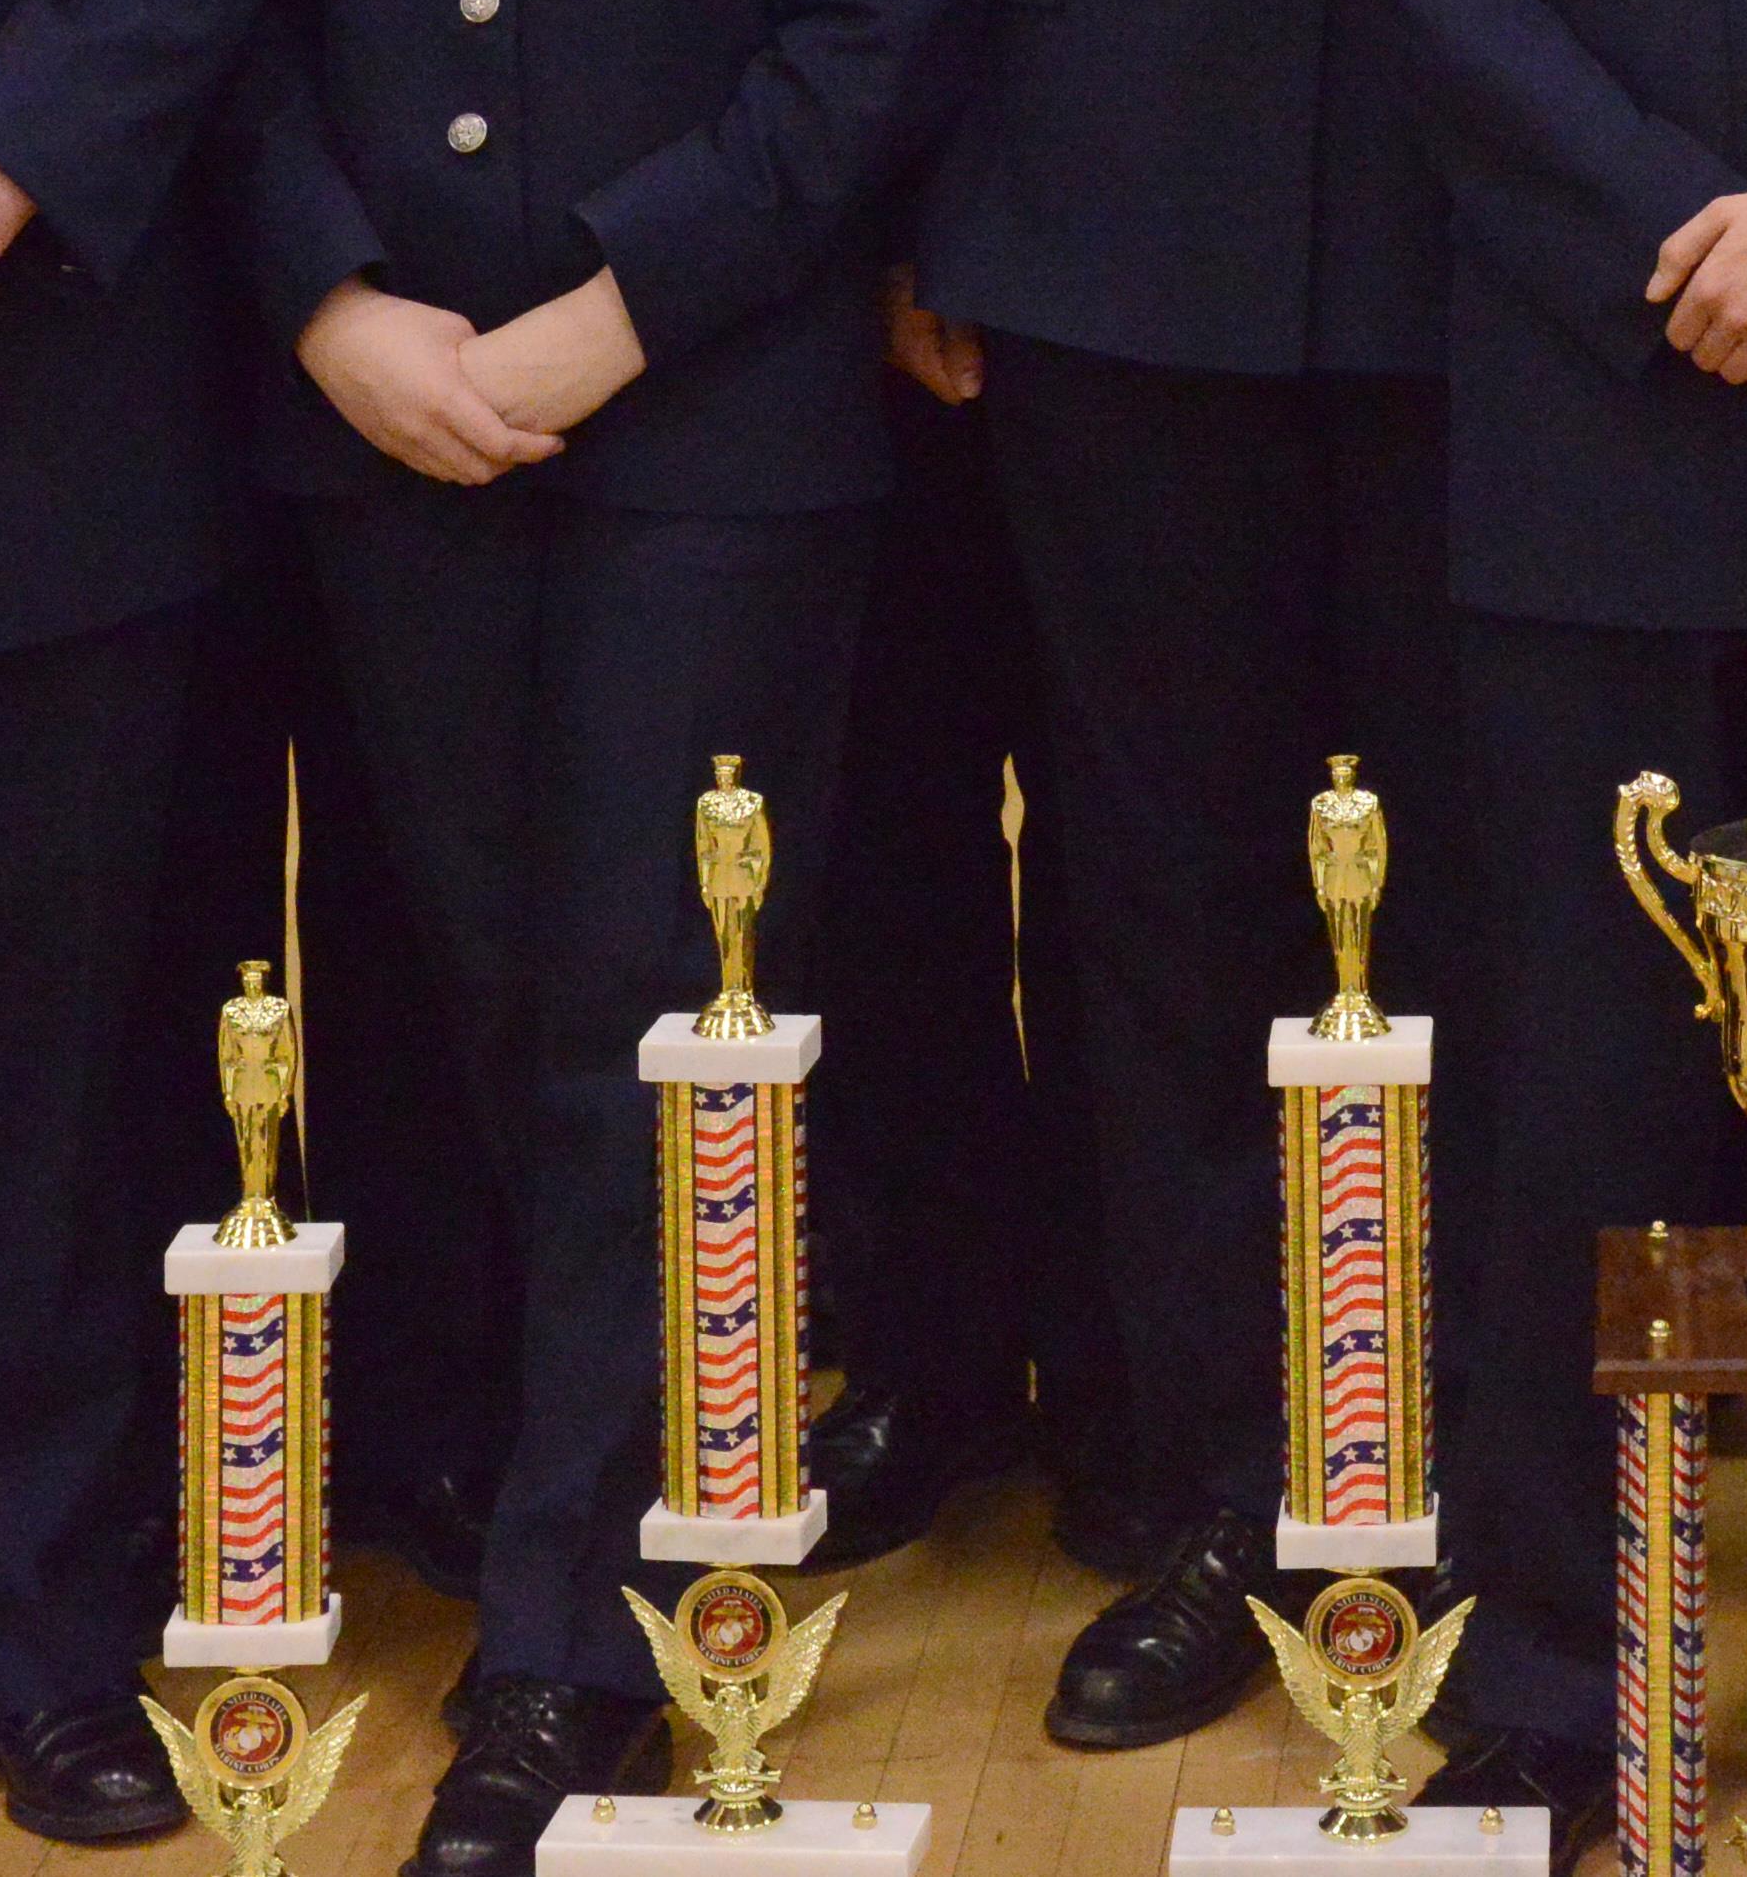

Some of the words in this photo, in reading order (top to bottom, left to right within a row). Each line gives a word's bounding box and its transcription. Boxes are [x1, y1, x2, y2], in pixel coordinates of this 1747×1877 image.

[698, 1586, 731, 1610] UNITED
[732, 1587, 763, 1611] STATES
[1330, 1593, 1367, 1614] UNITED
[1368, 1593, 1398, 1622] STATES
[699, 1642, 732, 1667] MARINE
[734, 1646, 767, 1667] CORPS
[1326, 1645, 1358, 1674] MARINE
[1359, 1656, 1393, 1675] CORPS
[221, 1692, 258, 1711] UNITED
[259, 1693, 289, 1722] STATES
[214, 1742, 247, 1773] MARINE
[247, 1755, 281, 1774] CORPS
